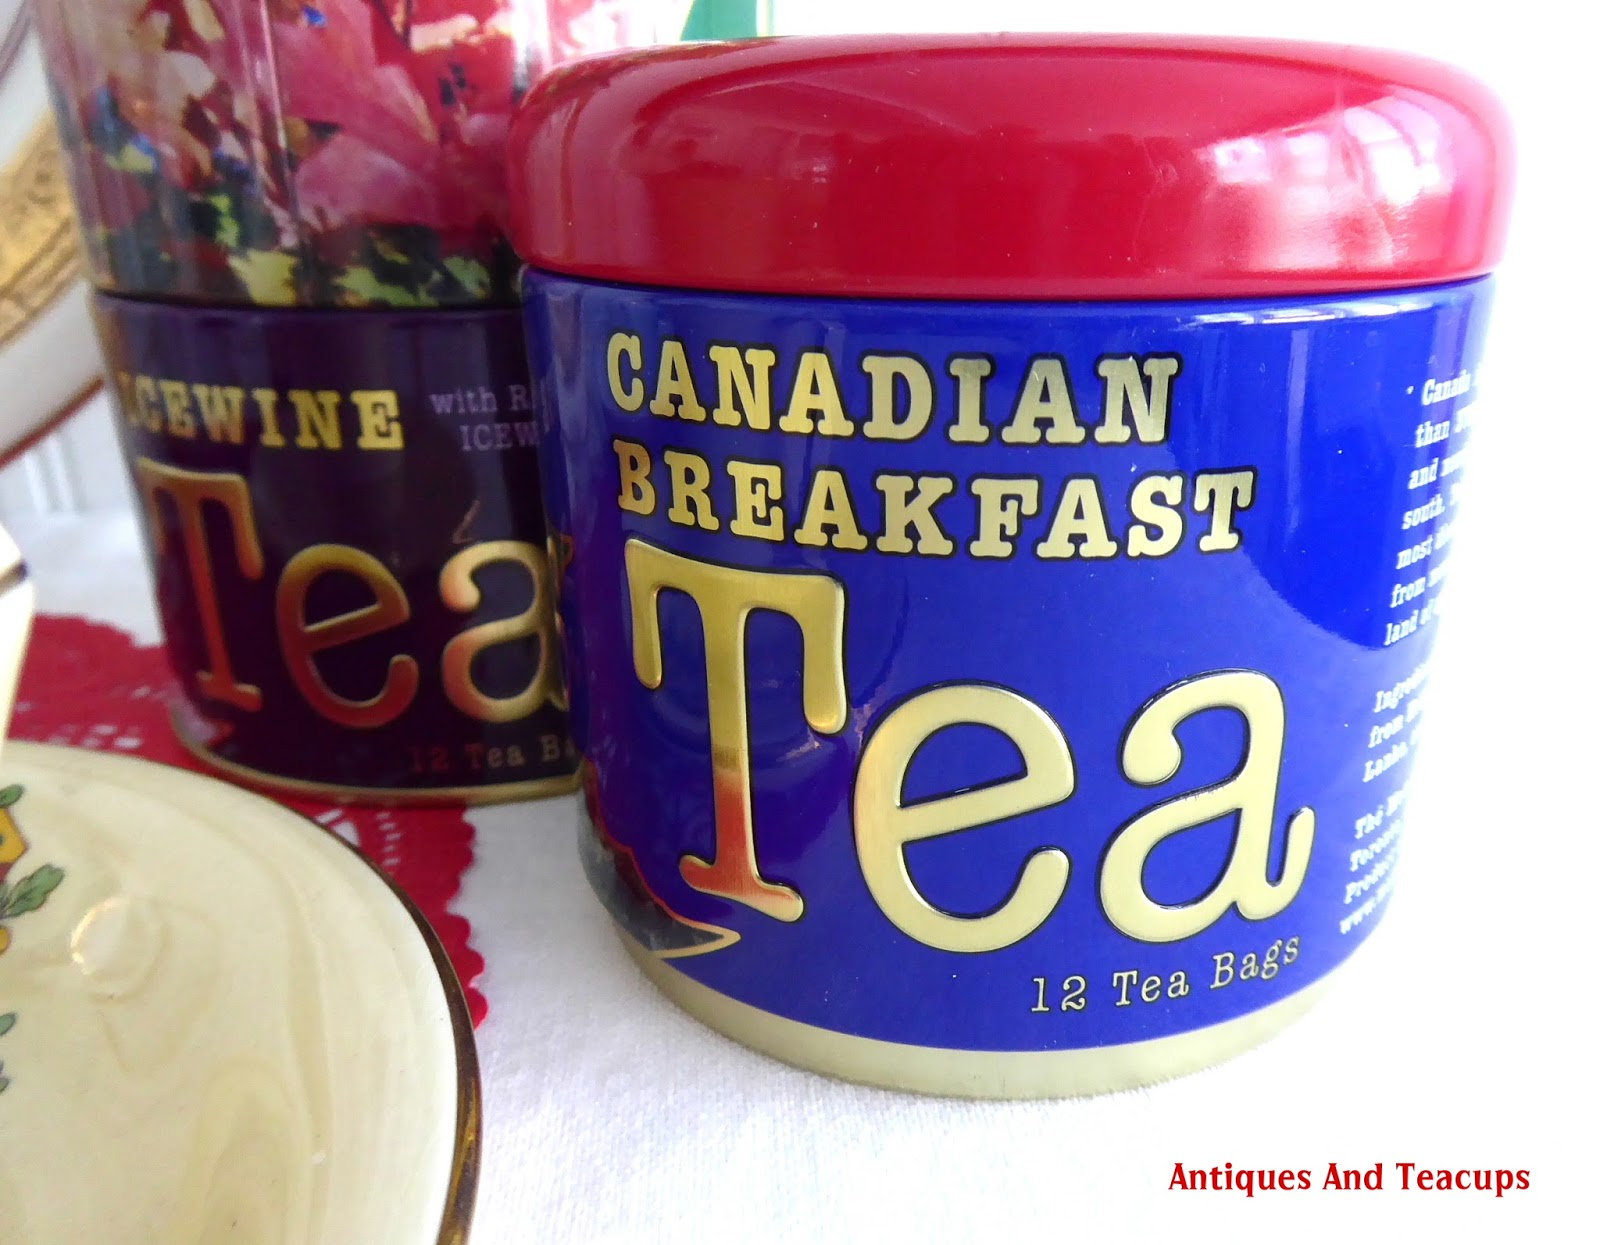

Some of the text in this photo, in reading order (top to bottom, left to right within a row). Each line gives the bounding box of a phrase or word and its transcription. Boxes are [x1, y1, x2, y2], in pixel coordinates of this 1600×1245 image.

[428, 385, 499, 415] with
[605, 331, 1181, 445] CANADIAN
[1414, 420, 1451, 449] than
[1407, 456, 1440, 490] and
[611, 438, 1256, 558] BREAKFAST
[1395, 533, 1434, 571] most
[135, 456, 570, 729] Tea
[1389, 575, 1427, 609] from
[1383, 608, 1420, 647] land
[464, 742, 527, 771] Tea
[623, 537, 1317, 953] Tea
[1030, 935, 1301, 1013] 12 Tea Bags
